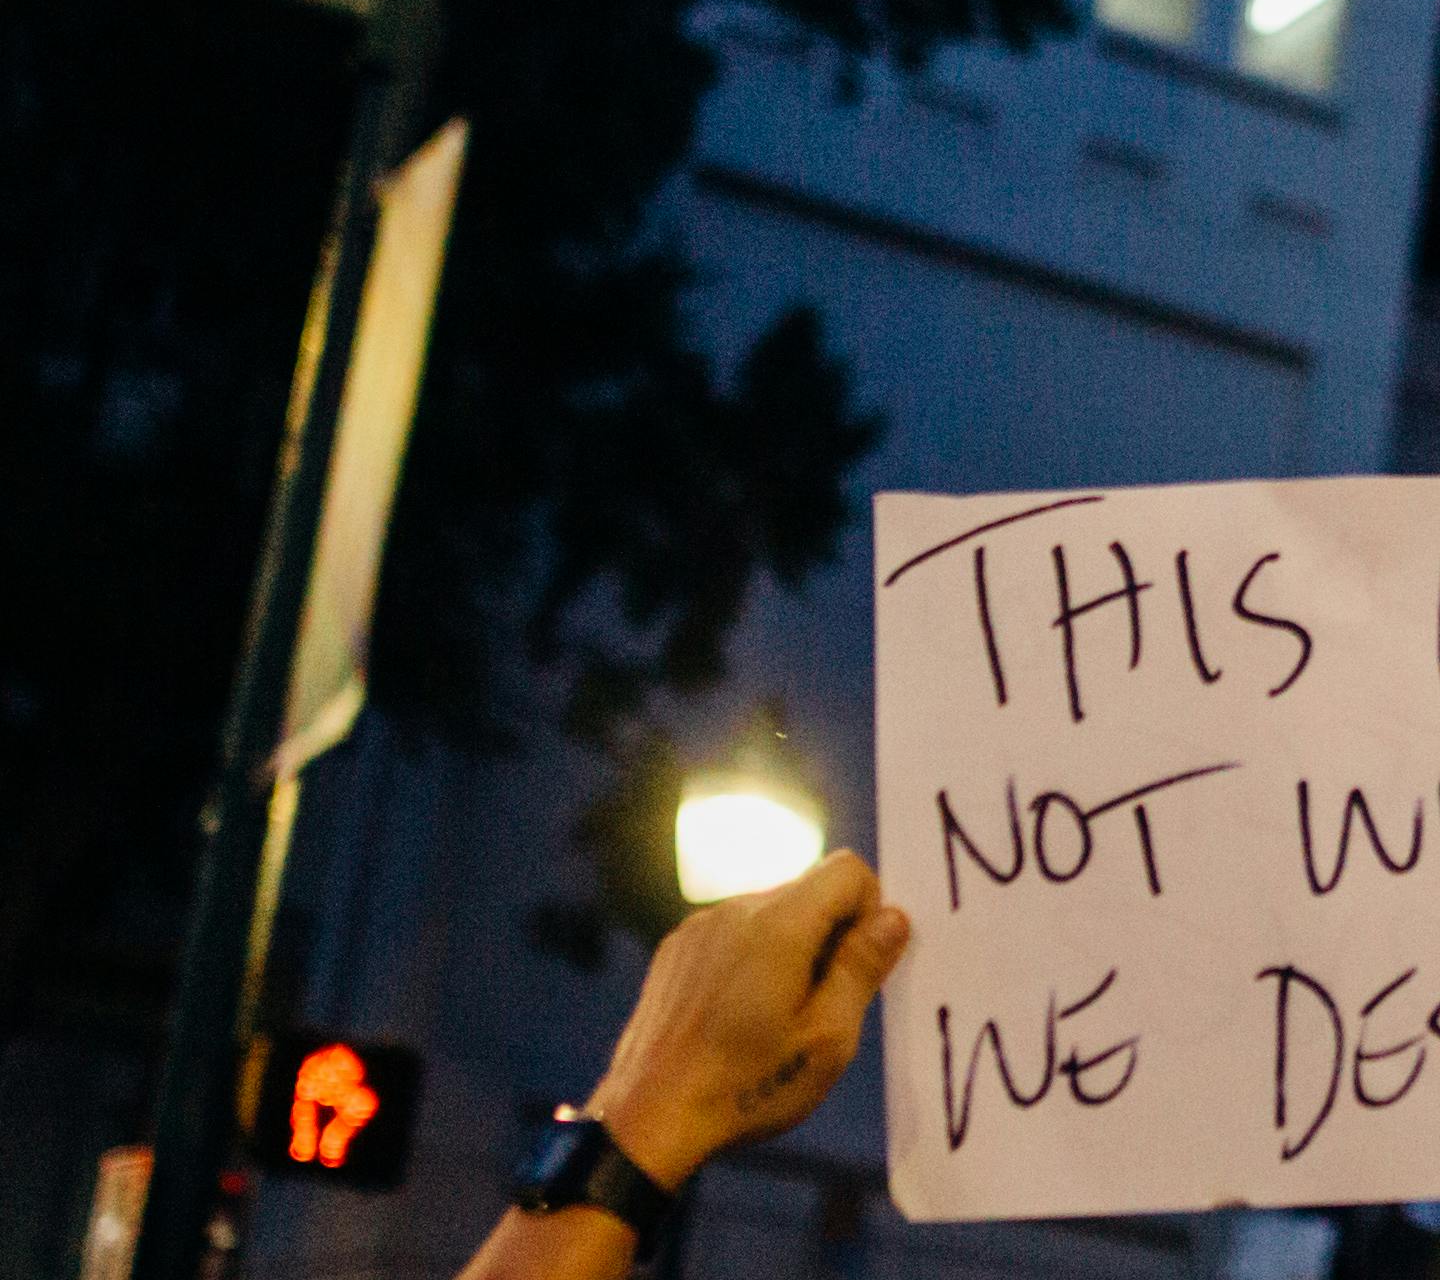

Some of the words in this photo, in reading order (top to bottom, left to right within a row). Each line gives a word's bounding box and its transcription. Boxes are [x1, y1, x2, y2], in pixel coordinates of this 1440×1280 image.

[885, 495, 1312, 722] THIS
[937, 761, 1241, 912] NOT
[937, 970, 1140, 1153] WE
